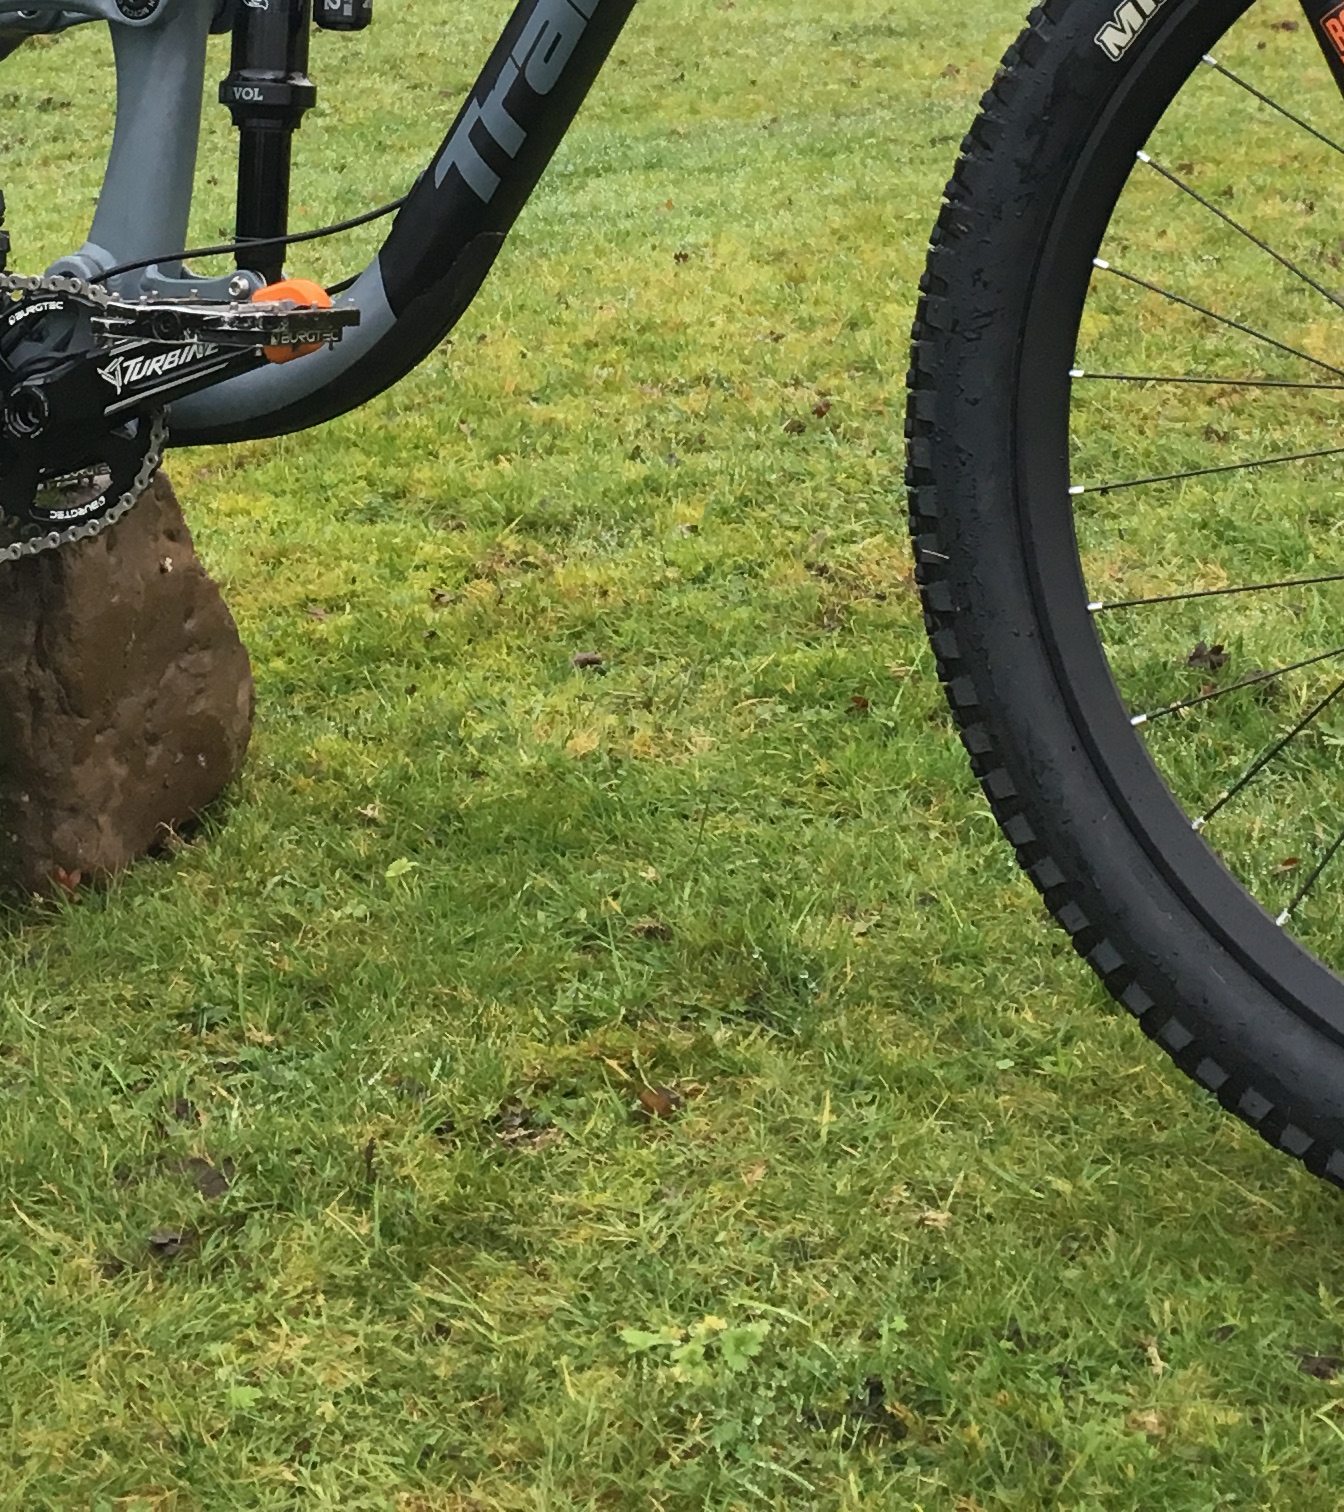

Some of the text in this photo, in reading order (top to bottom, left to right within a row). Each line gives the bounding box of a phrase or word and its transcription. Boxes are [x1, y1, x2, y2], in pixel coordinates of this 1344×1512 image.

[15, 300, 64, 320] BURGTEC
[280, 329, 339, 345] BURGTEC
[49, 499, 100, 520] BURGTEC
